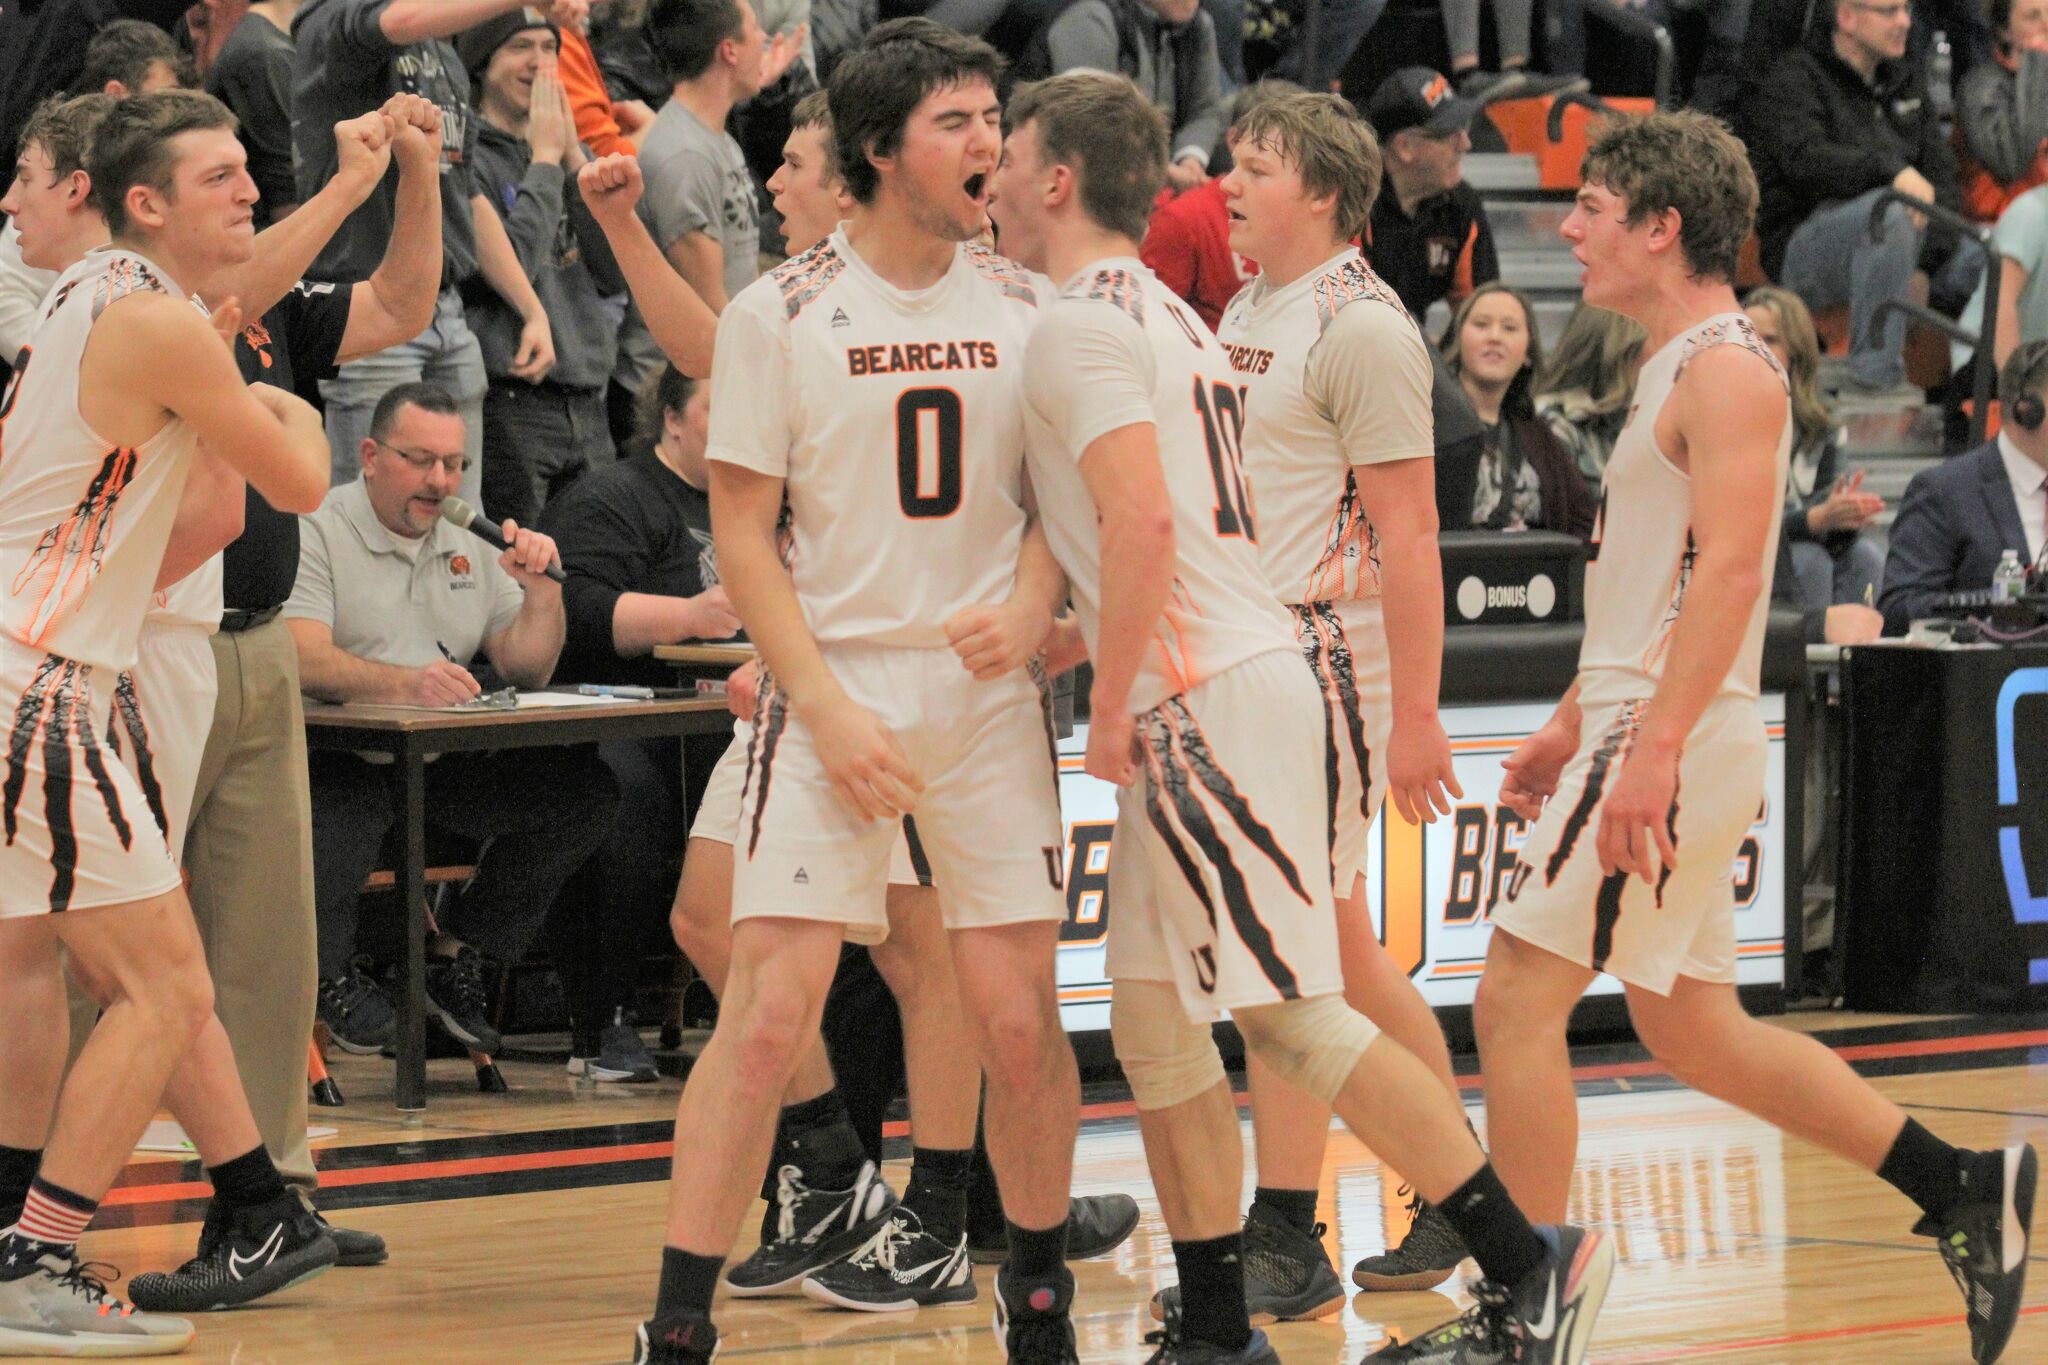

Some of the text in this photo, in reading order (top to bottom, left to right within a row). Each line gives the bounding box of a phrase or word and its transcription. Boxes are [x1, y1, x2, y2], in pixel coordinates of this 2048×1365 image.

[847, 340, 999, 377] BEARCATS
[1219, 342, 1275, 375] ARCATS
[895, 385, 965, 521] 0
[1487, 586, 1526, 608] BONUS
